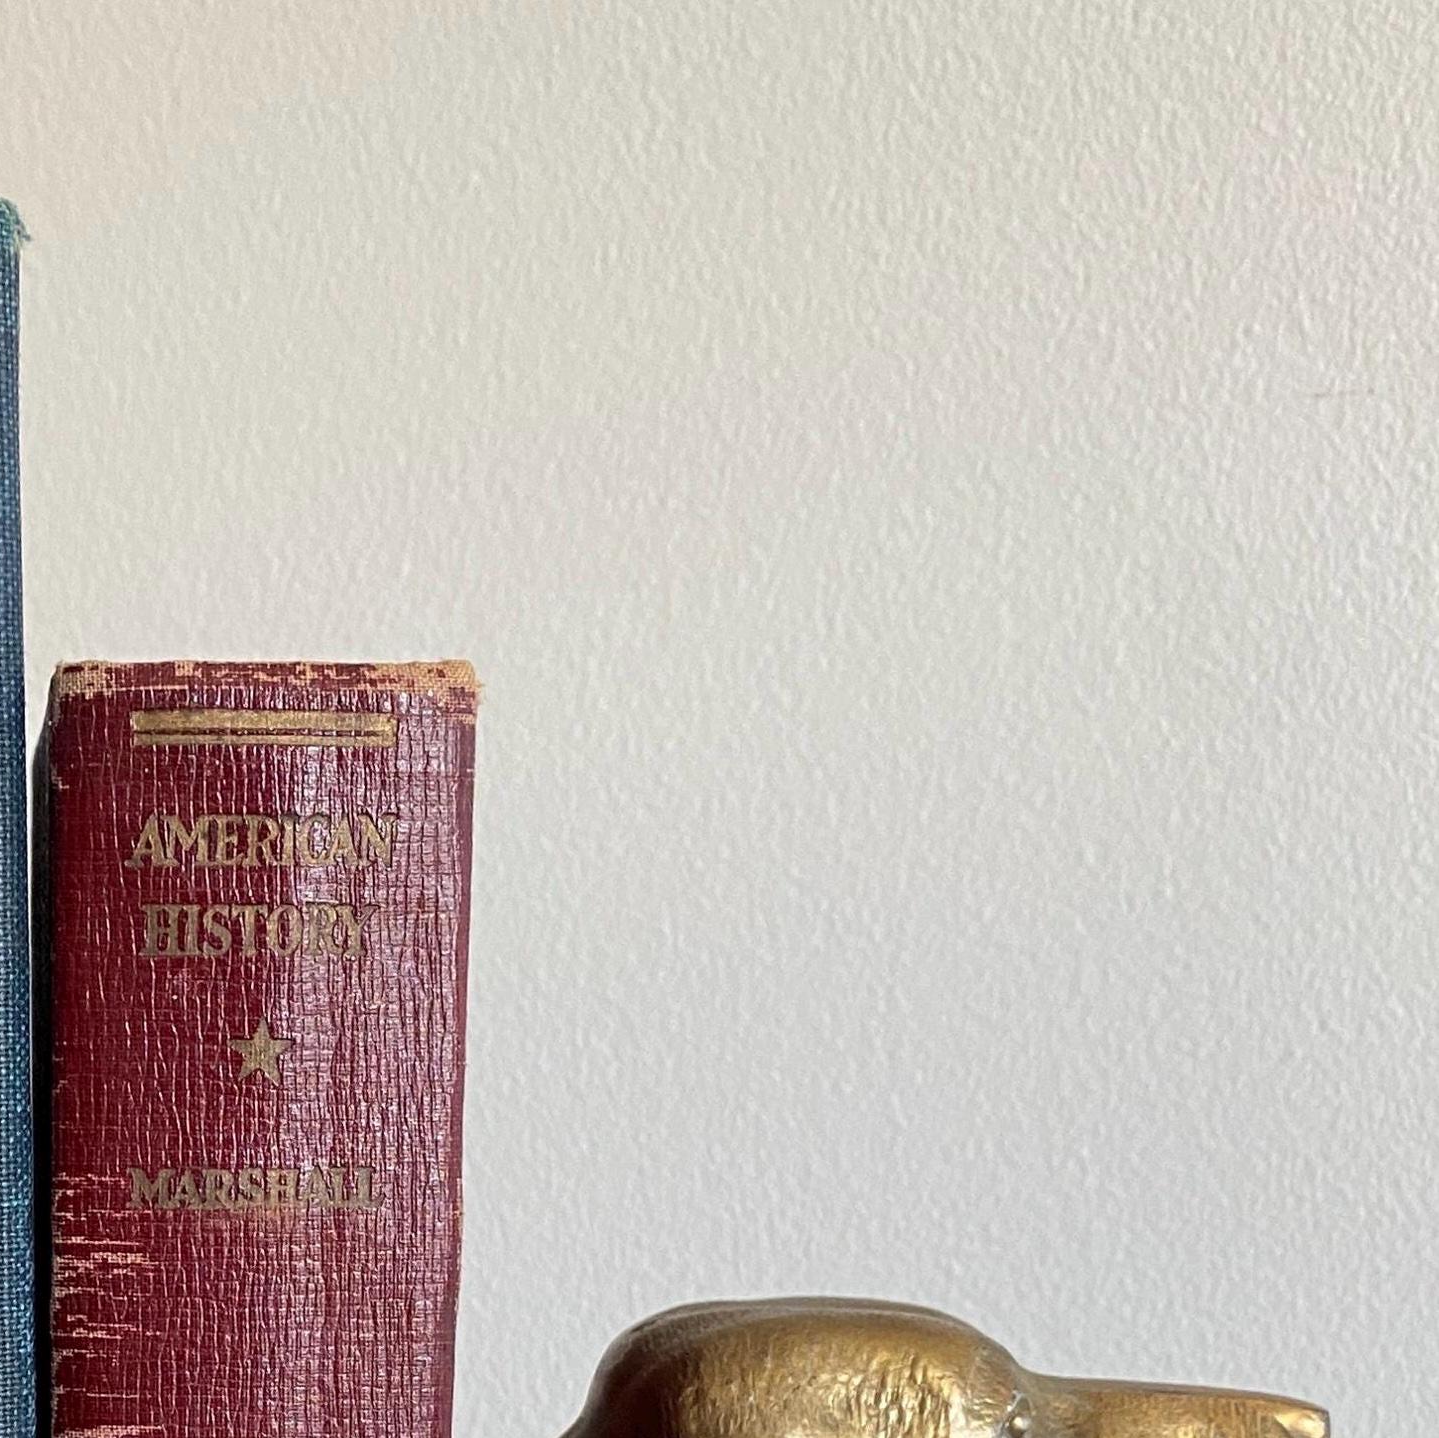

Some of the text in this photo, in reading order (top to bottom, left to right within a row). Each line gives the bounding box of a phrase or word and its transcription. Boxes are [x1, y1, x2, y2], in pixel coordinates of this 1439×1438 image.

[125, 813, 400, 869] AMERICAN
[138, 902, 380, 960] HISTORY
[127, 1166, 386, 1210] MARSHALL
